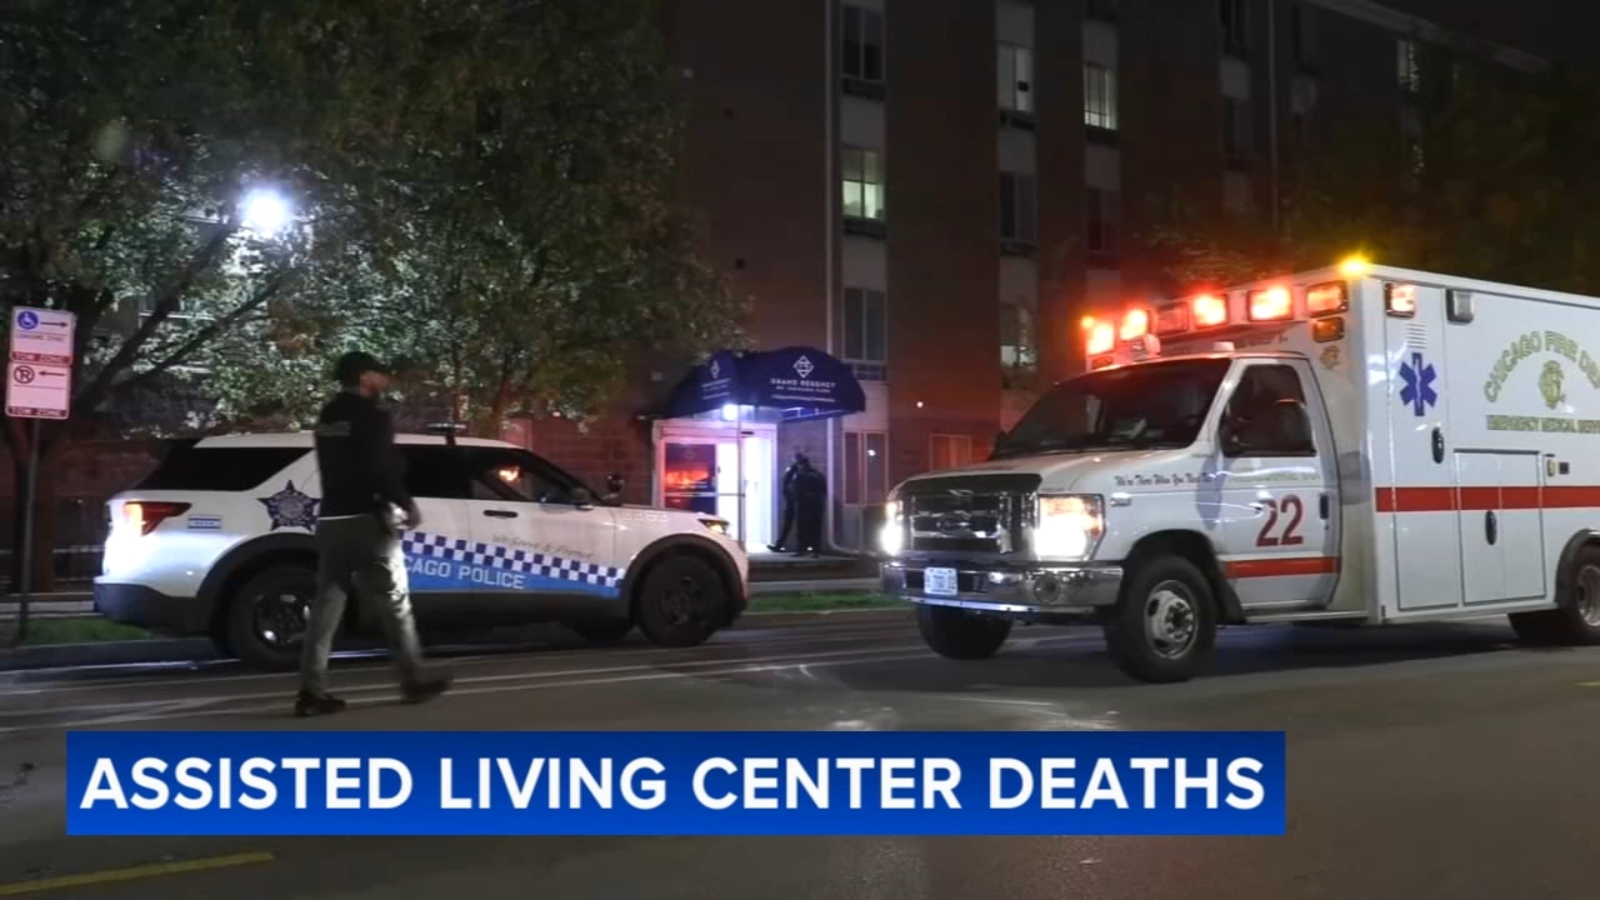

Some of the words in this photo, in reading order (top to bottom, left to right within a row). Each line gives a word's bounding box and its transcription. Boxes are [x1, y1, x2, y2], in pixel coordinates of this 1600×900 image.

[1484, 331, 1541, 403] CHICAGO
[1544, 330, 1577, 362] FIRE
[1256, 494, 1304, 547] 22
[404, 555, 451, 578] CAGO
[458, 566, 526, 590] POLICE
